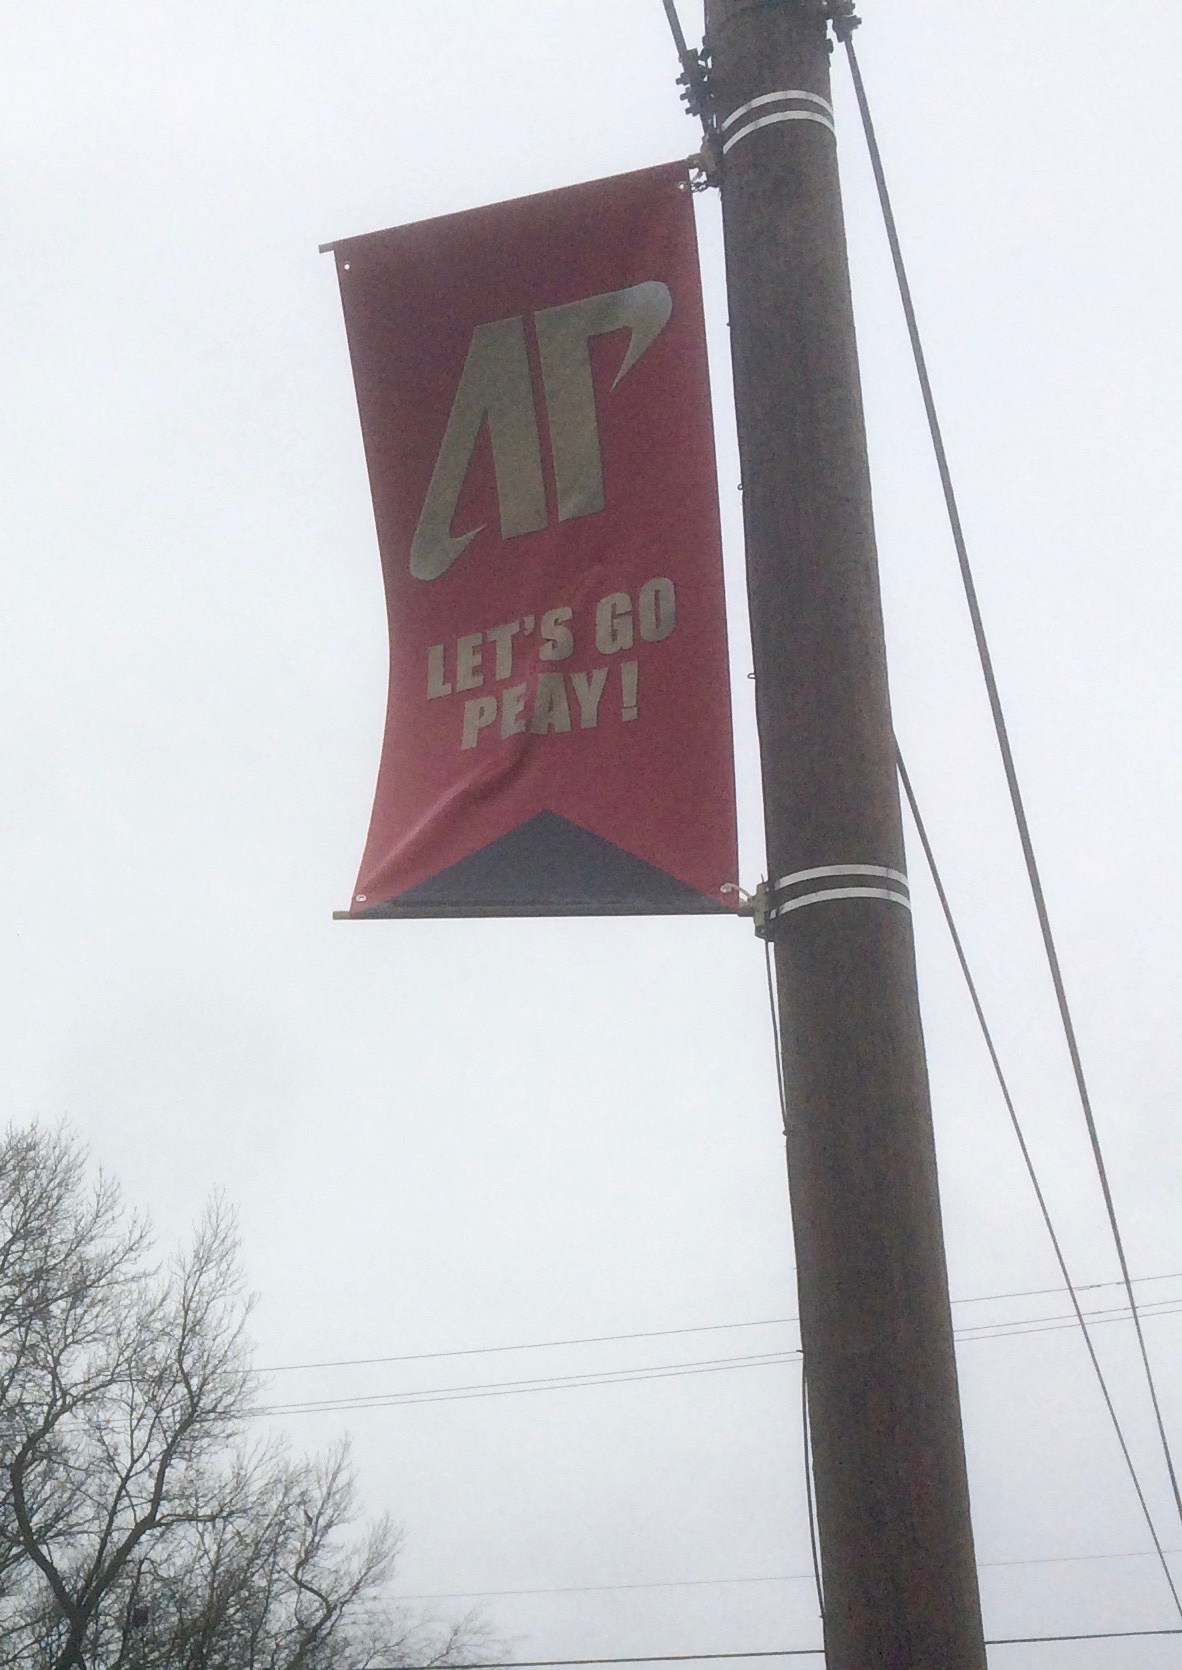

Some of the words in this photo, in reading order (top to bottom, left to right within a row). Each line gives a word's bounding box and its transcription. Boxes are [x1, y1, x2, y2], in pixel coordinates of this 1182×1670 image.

[426, 606, 574, 700] LET'S
[595, 576, 677, 655] GO
[460, 660, 639, 751] PEAY!
